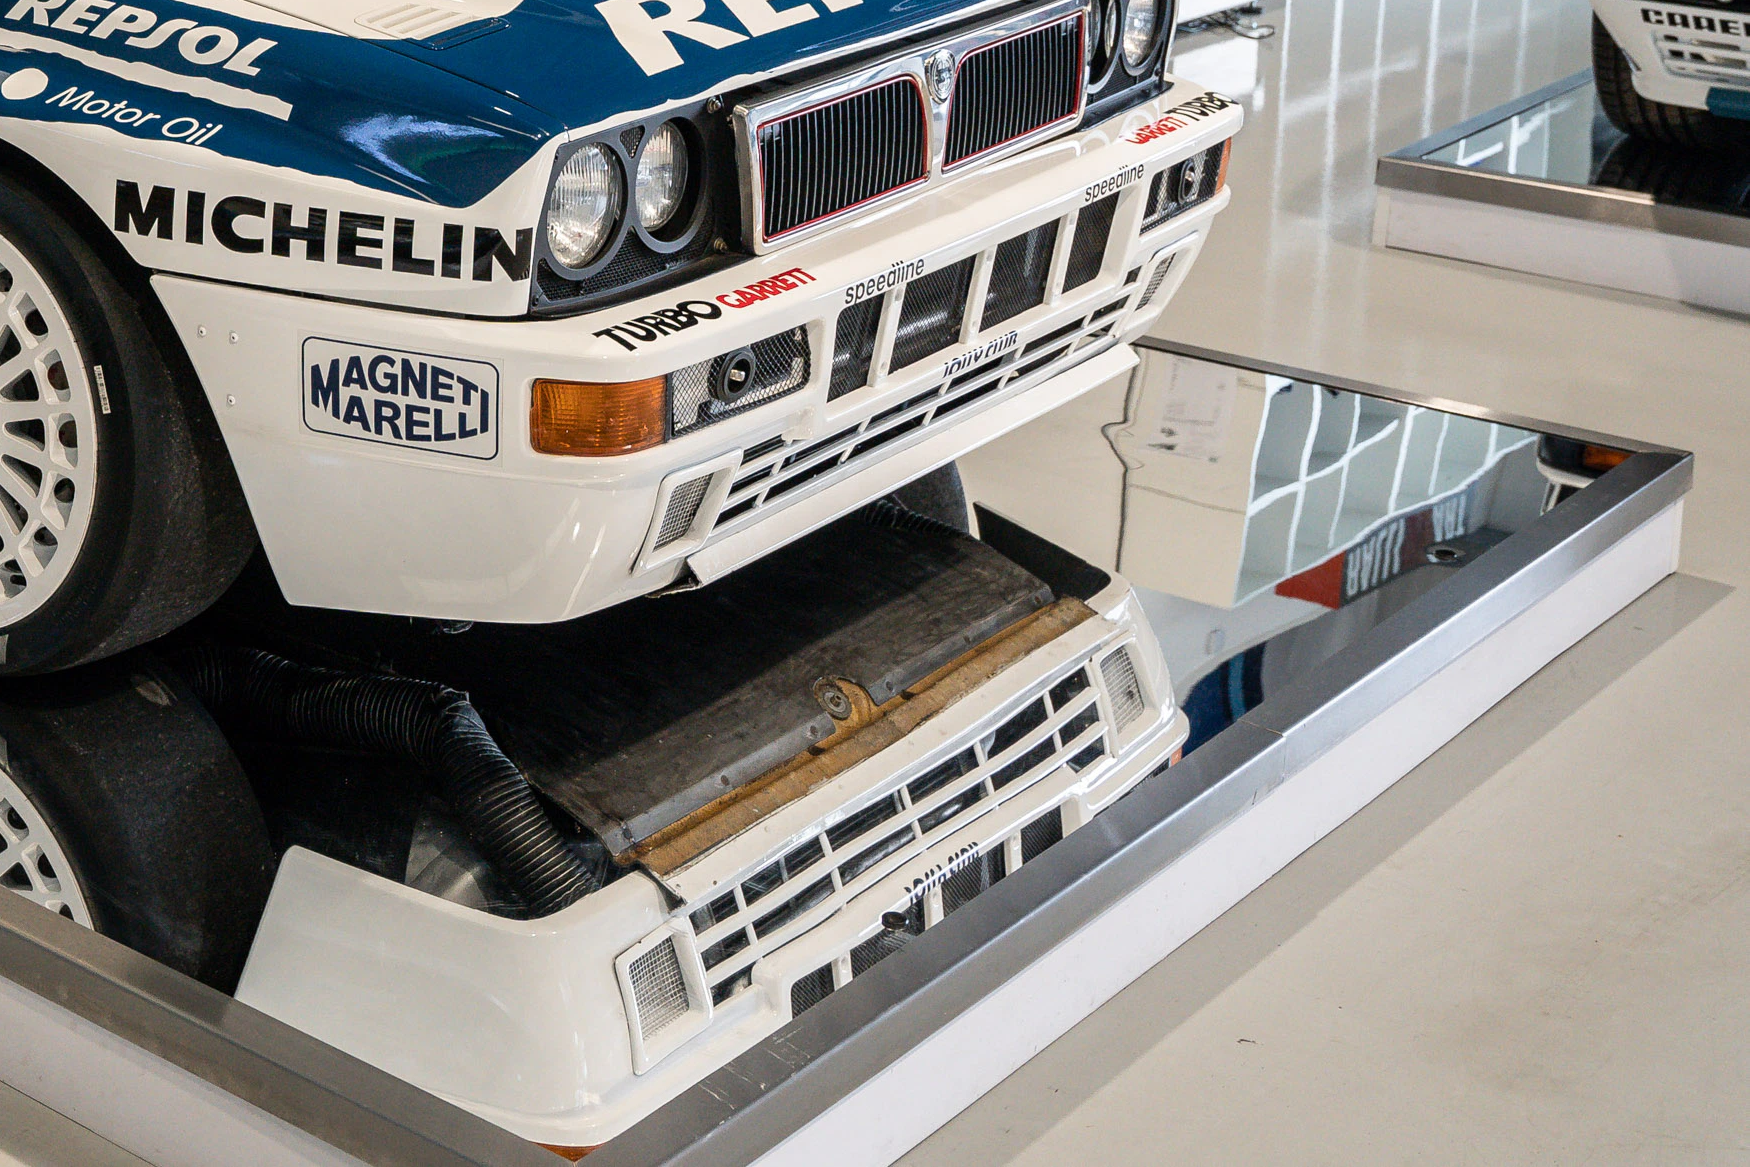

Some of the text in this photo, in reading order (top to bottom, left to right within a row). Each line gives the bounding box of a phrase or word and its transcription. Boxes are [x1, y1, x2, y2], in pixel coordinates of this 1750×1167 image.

[45, 85, 224, 147] Motor Oil
[1162, 91, 1240, 121] TURBO
[1084, 164, 1145, 203] speedline
[114, 179, 534, 282] MICHELIN
[844, 258, 925, 305] speedline
[592, 267, 817, 351] TURBO GARRETT
[311, 354, 489, 411] MAGNETI
[311, 390, 489, 442] MARELLI
